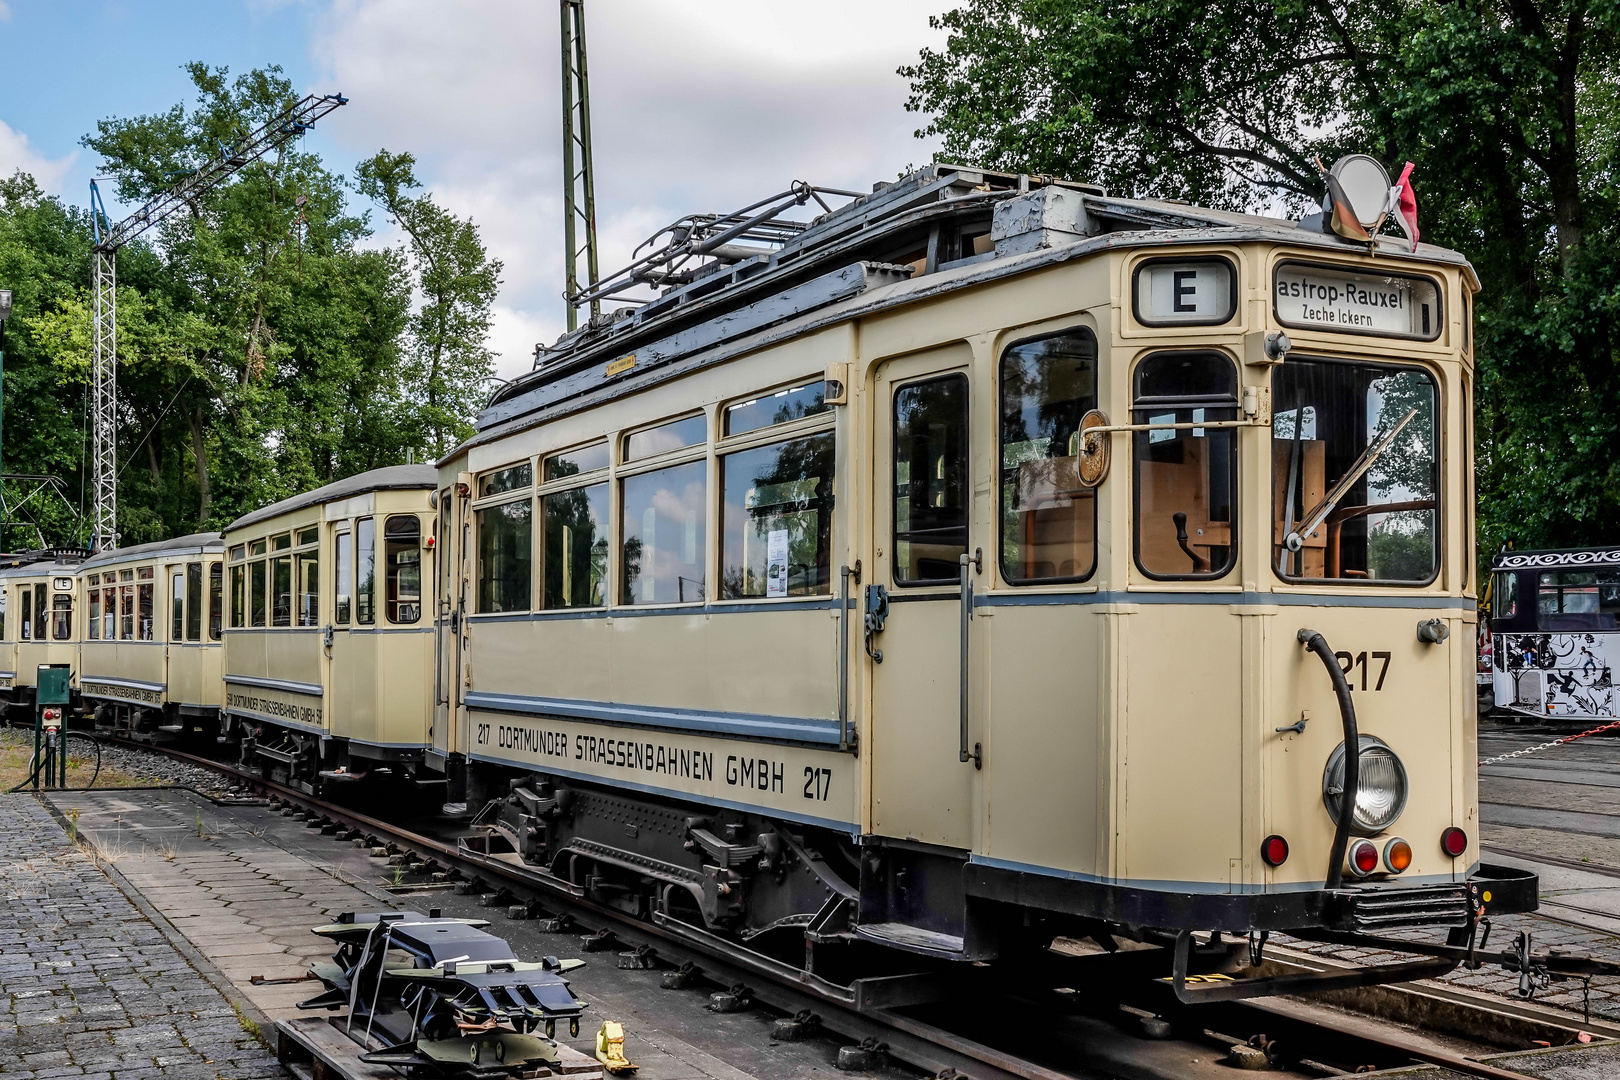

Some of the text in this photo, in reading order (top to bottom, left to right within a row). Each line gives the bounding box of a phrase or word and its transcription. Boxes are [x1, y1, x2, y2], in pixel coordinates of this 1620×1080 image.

[1173, 270, 1197, 312] E
[1302, 303, 1373, 326] Zeche Ickern
[62, 579, 67, 587] E
[233, 694, 259, 711] DORTMUNDER
[259, 698, 300, 720] STRASSENBAHNEN
[300, 706, 316, 723] GMBH
[477, 722, 832, 802] 217 DORTMUNDER STRASSENBAHNEN GMBH 217
